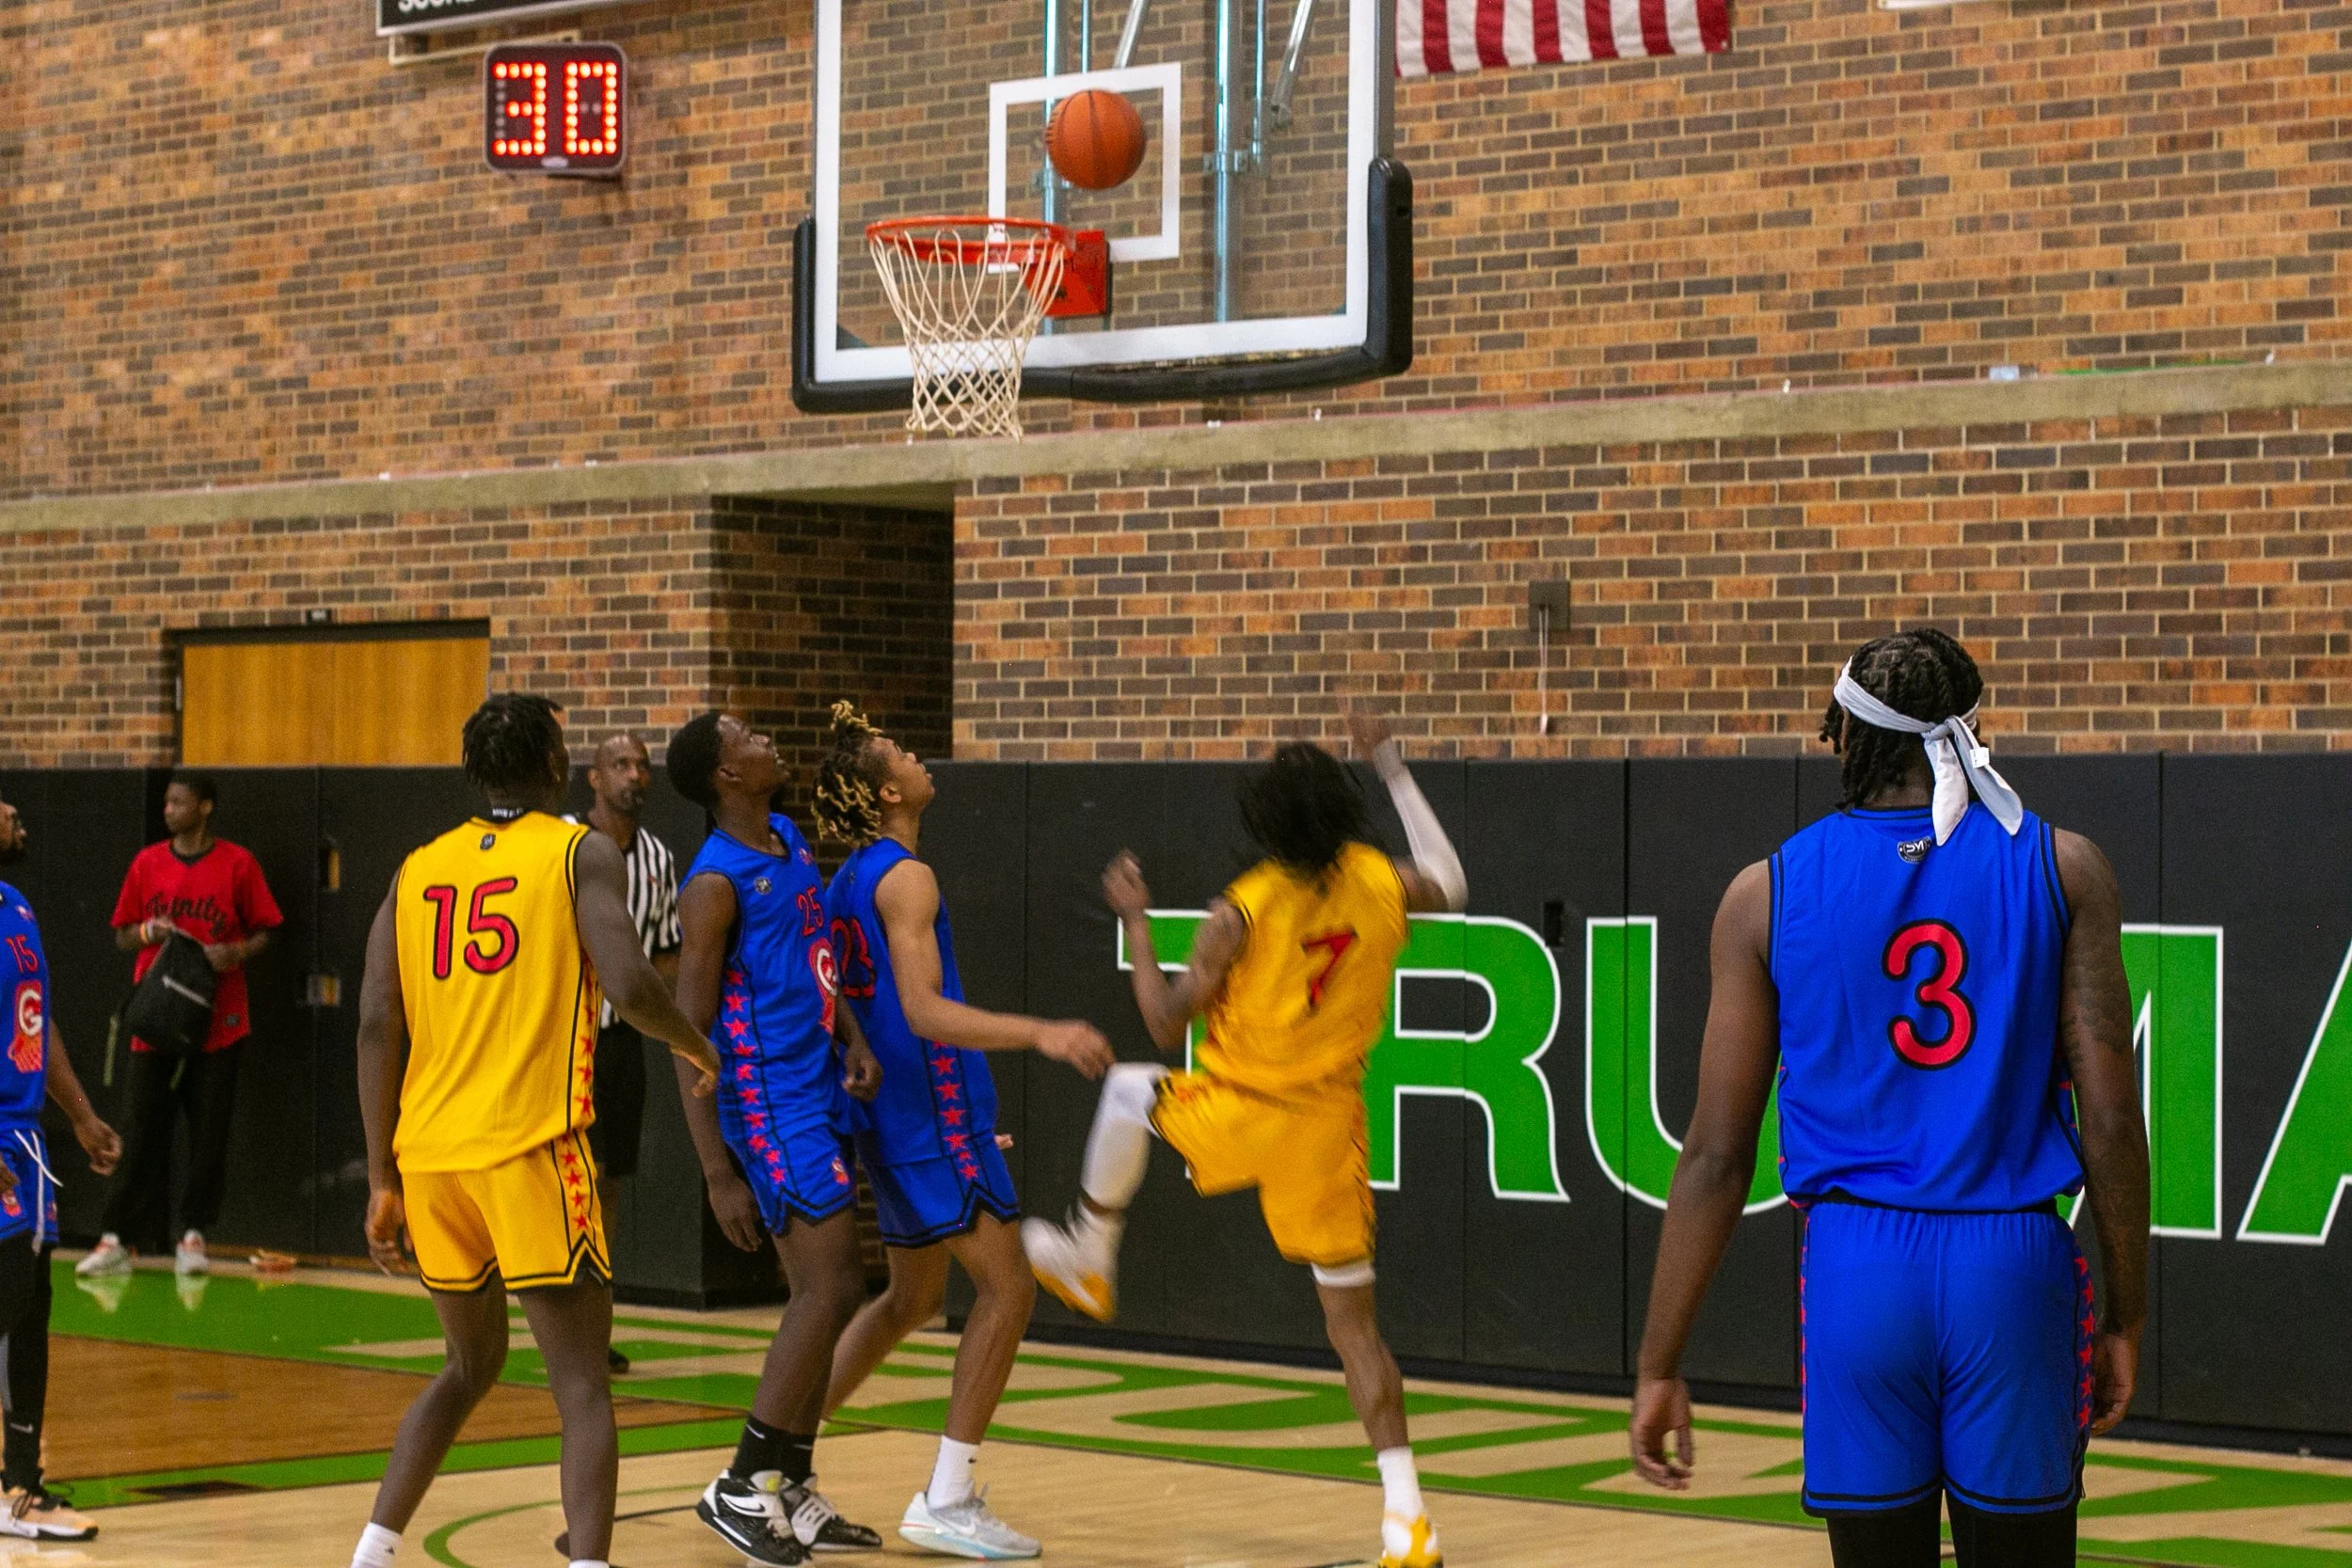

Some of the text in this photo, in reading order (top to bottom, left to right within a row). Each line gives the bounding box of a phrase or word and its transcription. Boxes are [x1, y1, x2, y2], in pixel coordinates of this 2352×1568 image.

[492, 60, 617, 156] 30
[7, 934, 39, 974] 15
[423, 877, 519, 980] 15
[795, 886, 824, 937] 25
[1300, 927, 1357, 1013] 7
[1882, 918, 1978, 1071] 3
